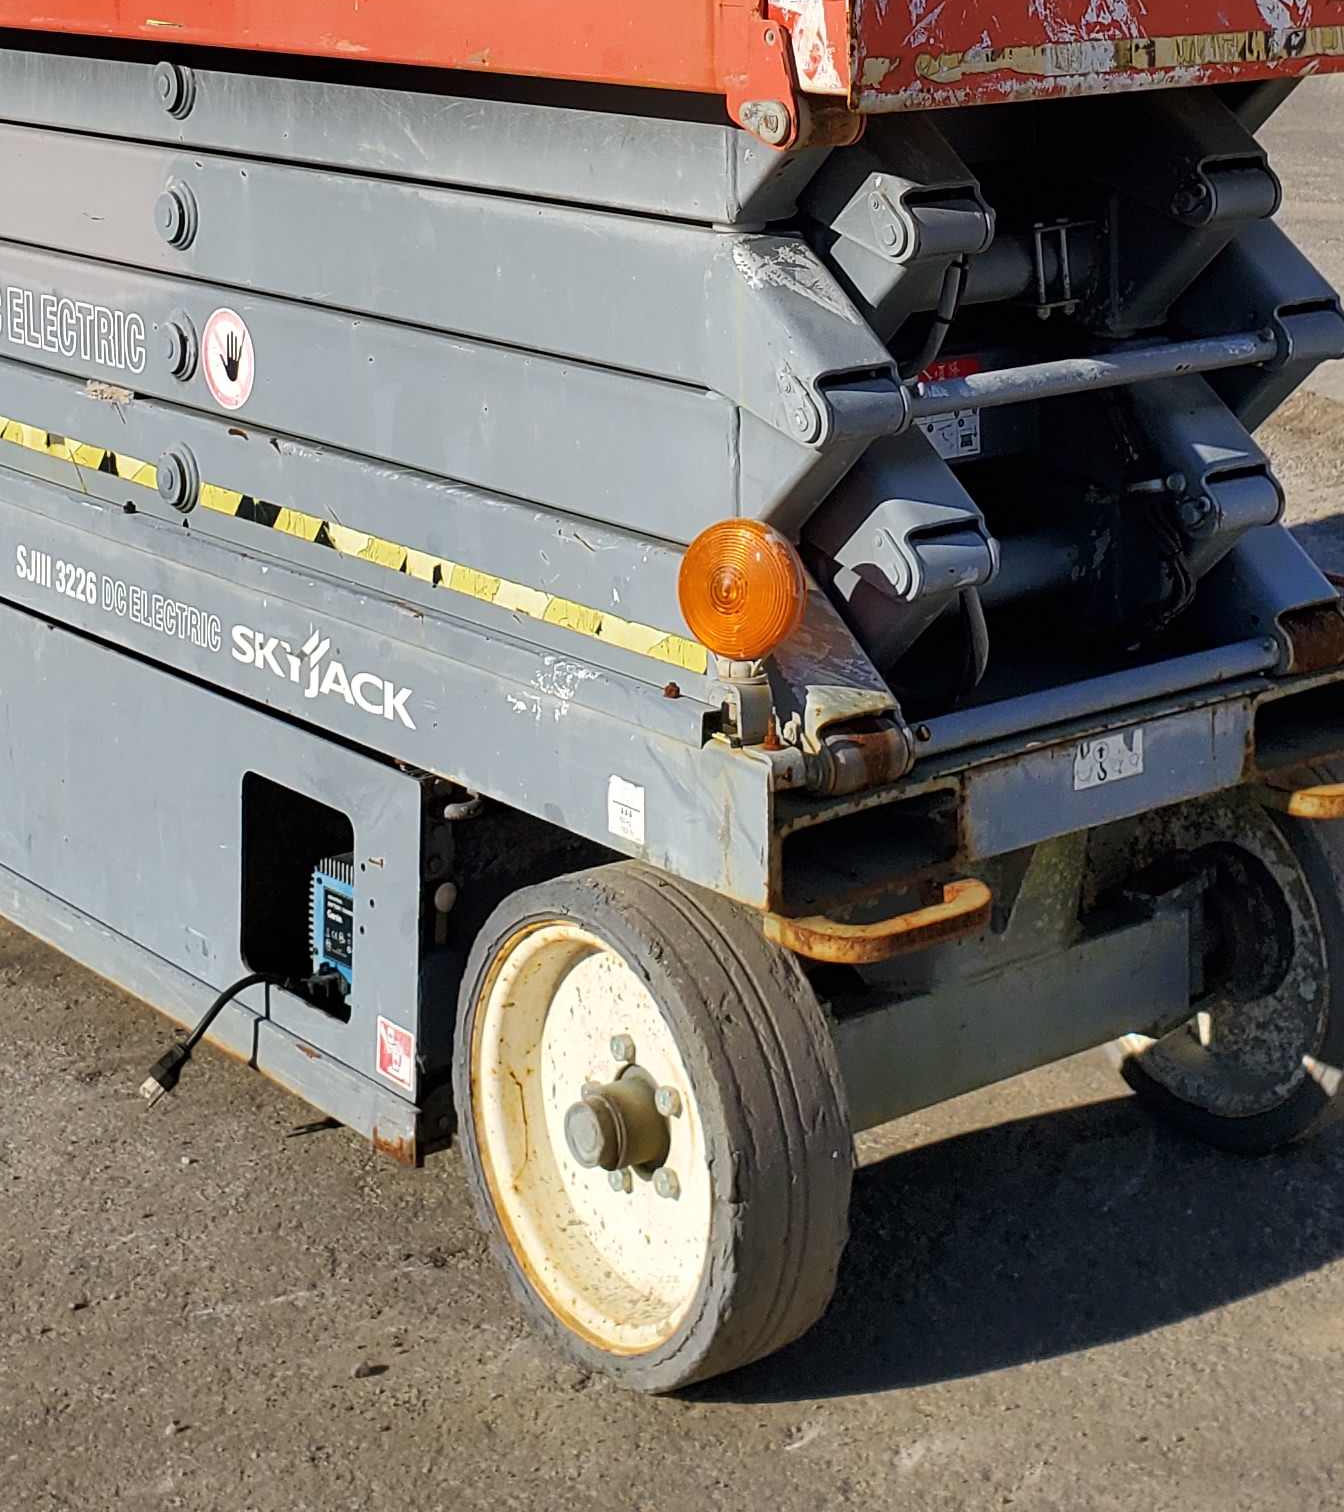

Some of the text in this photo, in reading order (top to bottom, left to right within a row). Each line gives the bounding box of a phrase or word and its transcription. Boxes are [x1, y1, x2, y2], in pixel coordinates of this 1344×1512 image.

[7, 286, 146, 374] ELECTRIC
[16, 544, 417, 730] SJIII 3226 DC ELECTRIC SKYJACK
